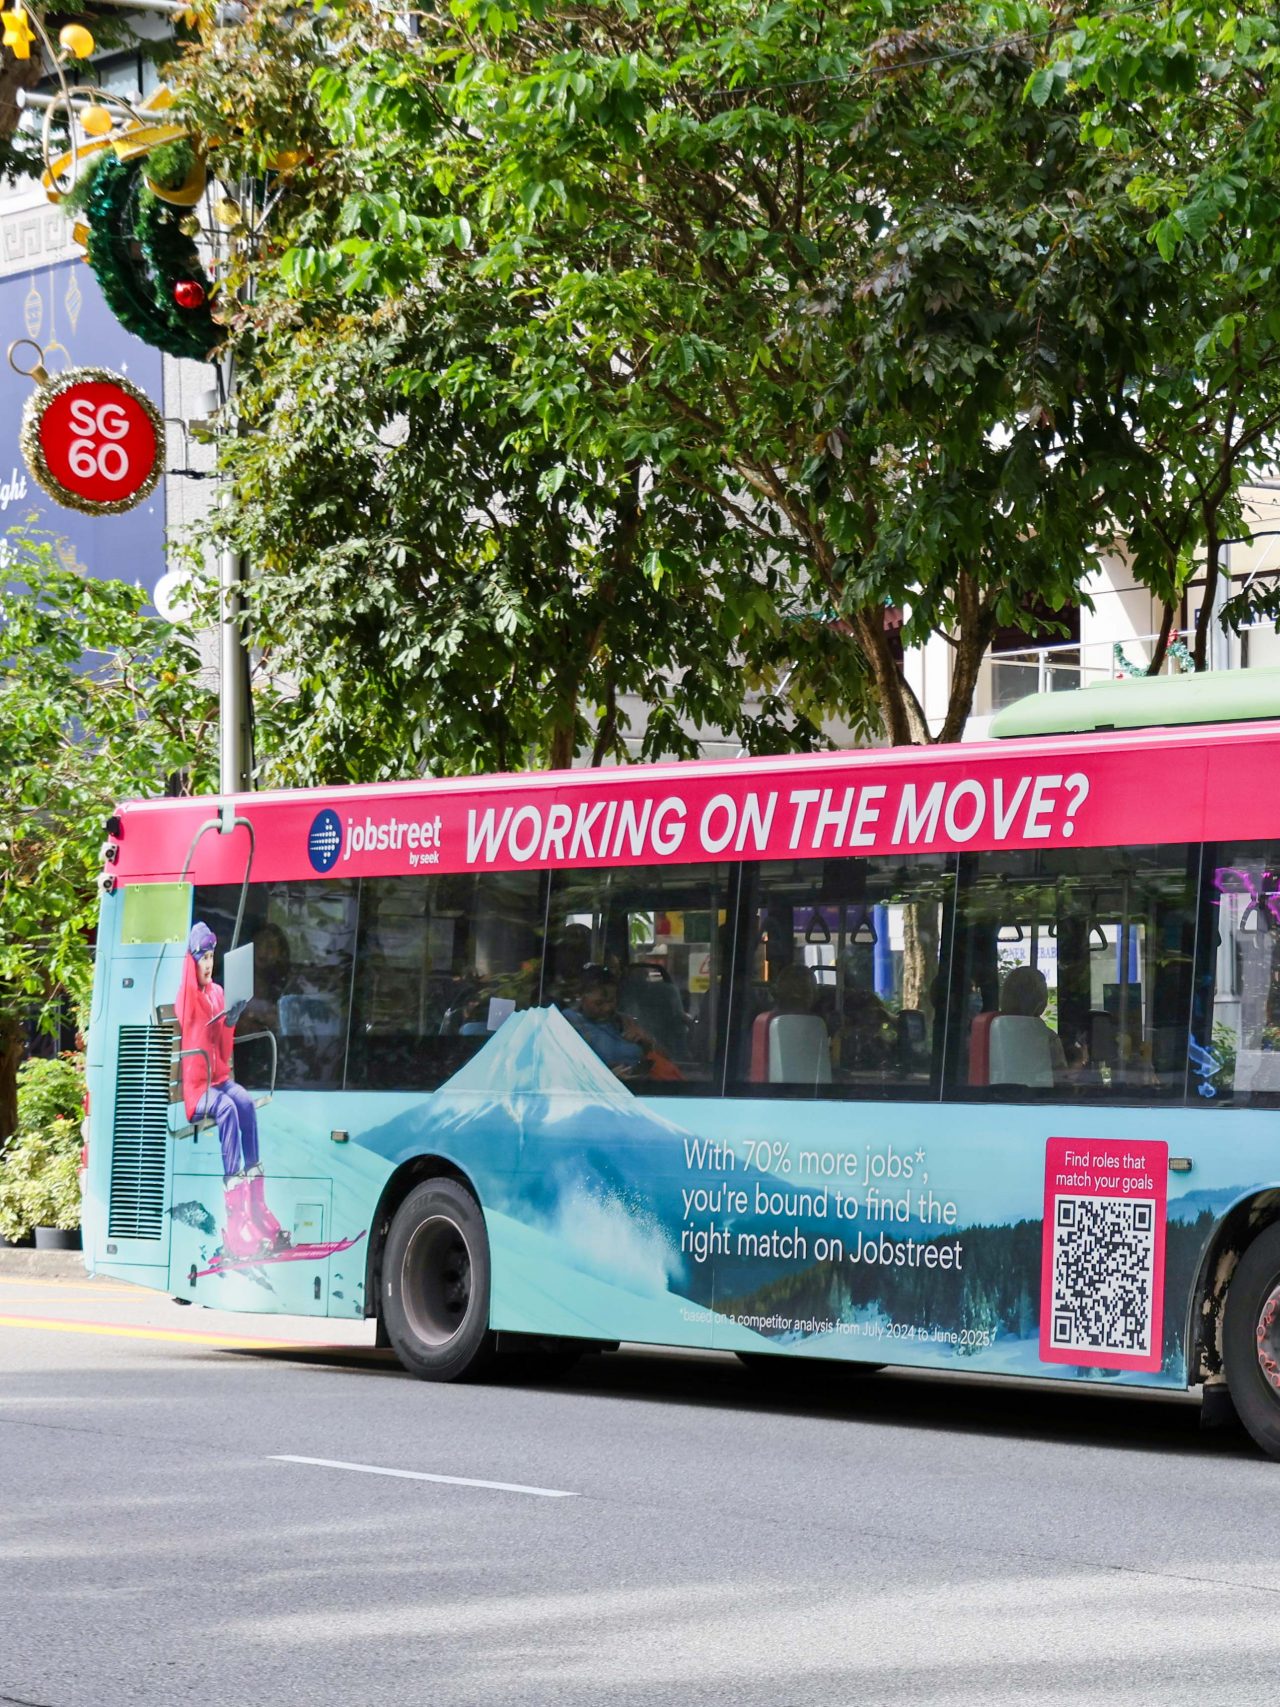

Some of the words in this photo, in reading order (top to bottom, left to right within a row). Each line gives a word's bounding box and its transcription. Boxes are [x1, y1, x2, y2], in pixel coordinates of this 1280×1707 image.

[68, 399, 130, 441] SG
[68, 439, 129, 481] 60
[0, 467, 27, 510] ght
[343, 814, 443, 861] jobstreet
[466, 796, 687, 865] WORKING
[700, 790, 779, 854] ON
[788, 783, 888, 850] THE
[891, 772, 1091, 845] MOVE?
[409, 852, 420, 867] by
[420, 851, 440, 865] seek
[683, 1138, 735, 1171] With
[742, 1140, 792, 1173] 70%
[799, 1151, 858, 1176] more
[1064, 1151, 1090, 1167] Find
[1092, 1153, 1120, 1169] roles
[1122, 1153, 1146, 1170] that
[682, 1181, 749, 1221] you're
[755, 1181, 828, 1218] bound
[835, 1190, 859, 1220] to
[866, 1186, 911, 1224] find
[918, 1189, 957, 1225] the
[1056, 1170, 1091, 1187] match
[1094, 1175, 1121, 1192] your
[1122, 1174, 1154, 1194] goals
[681, 1222, 731, 1263] right
[737, 1226, 807, 1260] match
[814, 1238, 843, 1262] on
[849, 1230, 963, 1270] Jobstreet
[714, 1312, 728, 1325] on
[729, 1314, 736, 1326] a
[737, 1313, 793, 1332] competitor
[794, 1316, 834, 1336] analysis
[836, 1318, 860, 1336] from
[862, 1321, 885, 1341] July
[886, 1322, 916, 1341] 2024
[918, 1327, 929, 1342] to
[931, 1328, 958, 1344] June
